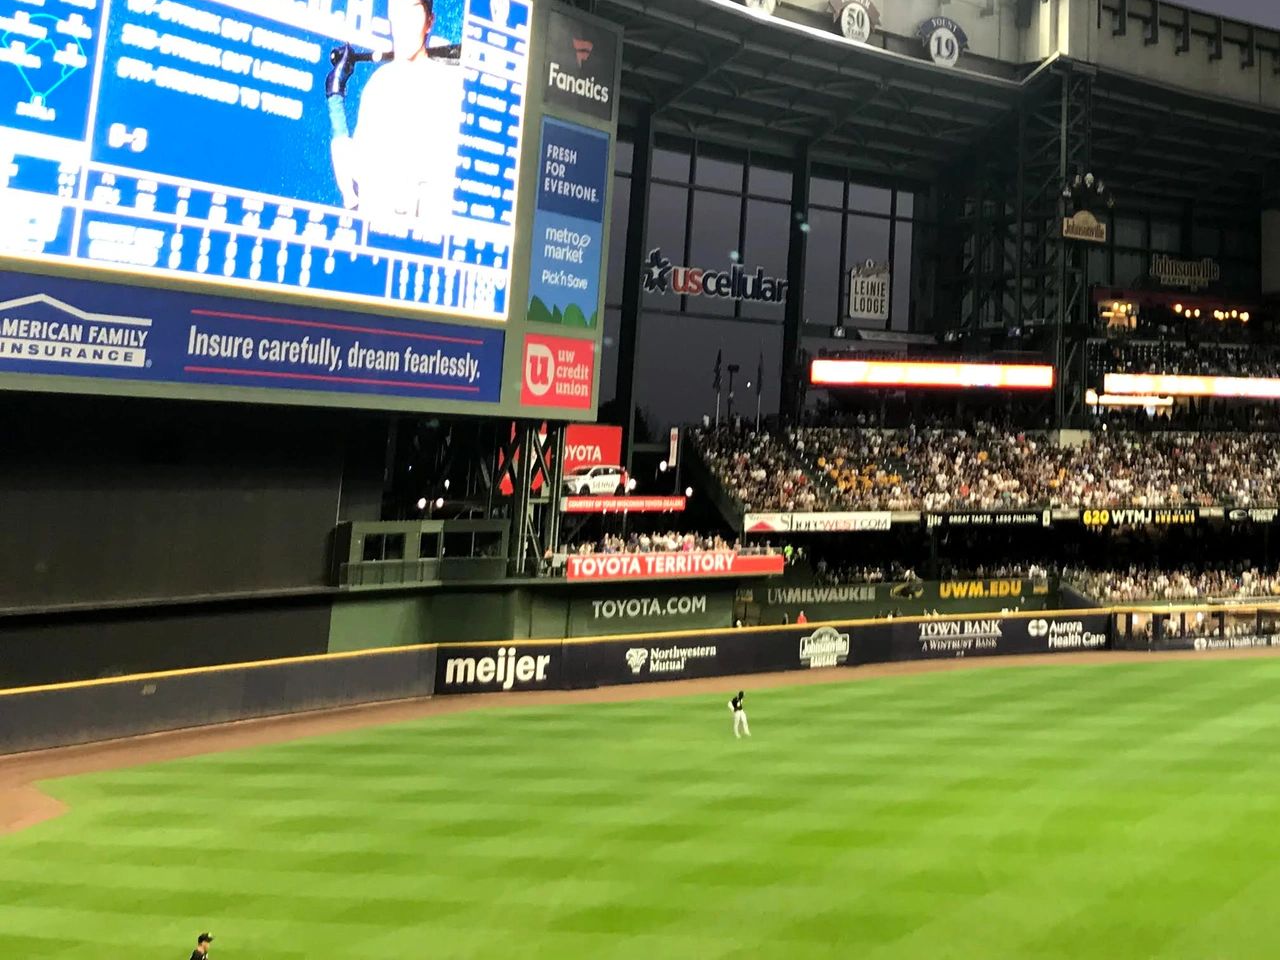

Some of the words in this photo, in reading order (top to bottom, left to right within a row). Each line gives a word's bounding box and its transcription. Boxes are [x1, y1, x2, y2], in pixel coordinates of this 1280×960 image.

[846, 8, 865, 28] 50
[931, 17, 958, 32] YOUNT
[934, 35, 956, 60] 19
[548, 62, 609, 104] Fanatics
[546, 143, 578, 165] FRESH
[545, 160, 566, 178] FOR
[544, 177, 599, 202] EVERYONE.
[545, 226, 580, 245] metro
[543, 244, 584, 265] market
[1149, 252, 1220, 281] Johnsonville
[567, 272, 588, 290] Save
[671, 262, 789, 303] uscellular
[854, 279, 886, 298] LEINIE
[853, 295, 886, 314] LODGE
[0, 317, 84, 343] MERICAN
[88, 325, 149, 347] FAMILY
[0, 342, 134, 363] INSURANCE
[187, 325, 254, 360] Insure
[257, 334, 343, 372] carefully,
[347, 341, 400, 373] dream
[403, 346, 481, 384] fearlessly.
[557, 348, 576, 363] uw
[556, 363, 589, 381] credit
[555, 379, 589, 397] union
[949, 514, 970, 524] GREAT
[995, 514, 1012, 524] LESS
[1083, 510, 1109, 526] 620
[1111, 508, 1152, 525] WTMJ
[572, 557, 641, 576] TOYOTA
[645, 553, 735, 575] TERRITORY
[939, 580, 1022, 598] UWM.EDU
[592, 595, 707, 619] TOYOTA.COM
[918, 621, 961, 637] TOWN
[964, 620, 1002, 635] BANK
[1050, 620, 1083, 634] Aurora
[802, 636, 847, 656] Johnsonville
[921, 642, 928, 652] A
[1048, 632, 1082, 648] Health
[1082, 631, 1106, 646] Care
[1207, 638, 1230, 648] Aurora
[1230, 637, 1252, 648] Health
[1252, 635, 1268, 646] Care
[650, 644, 717, 660] Northwestern
[810, 655, 838, 668] SAUSAGE
[445, 647, 551, 690] meijer
[649, 657, 686, 673] Mutual
